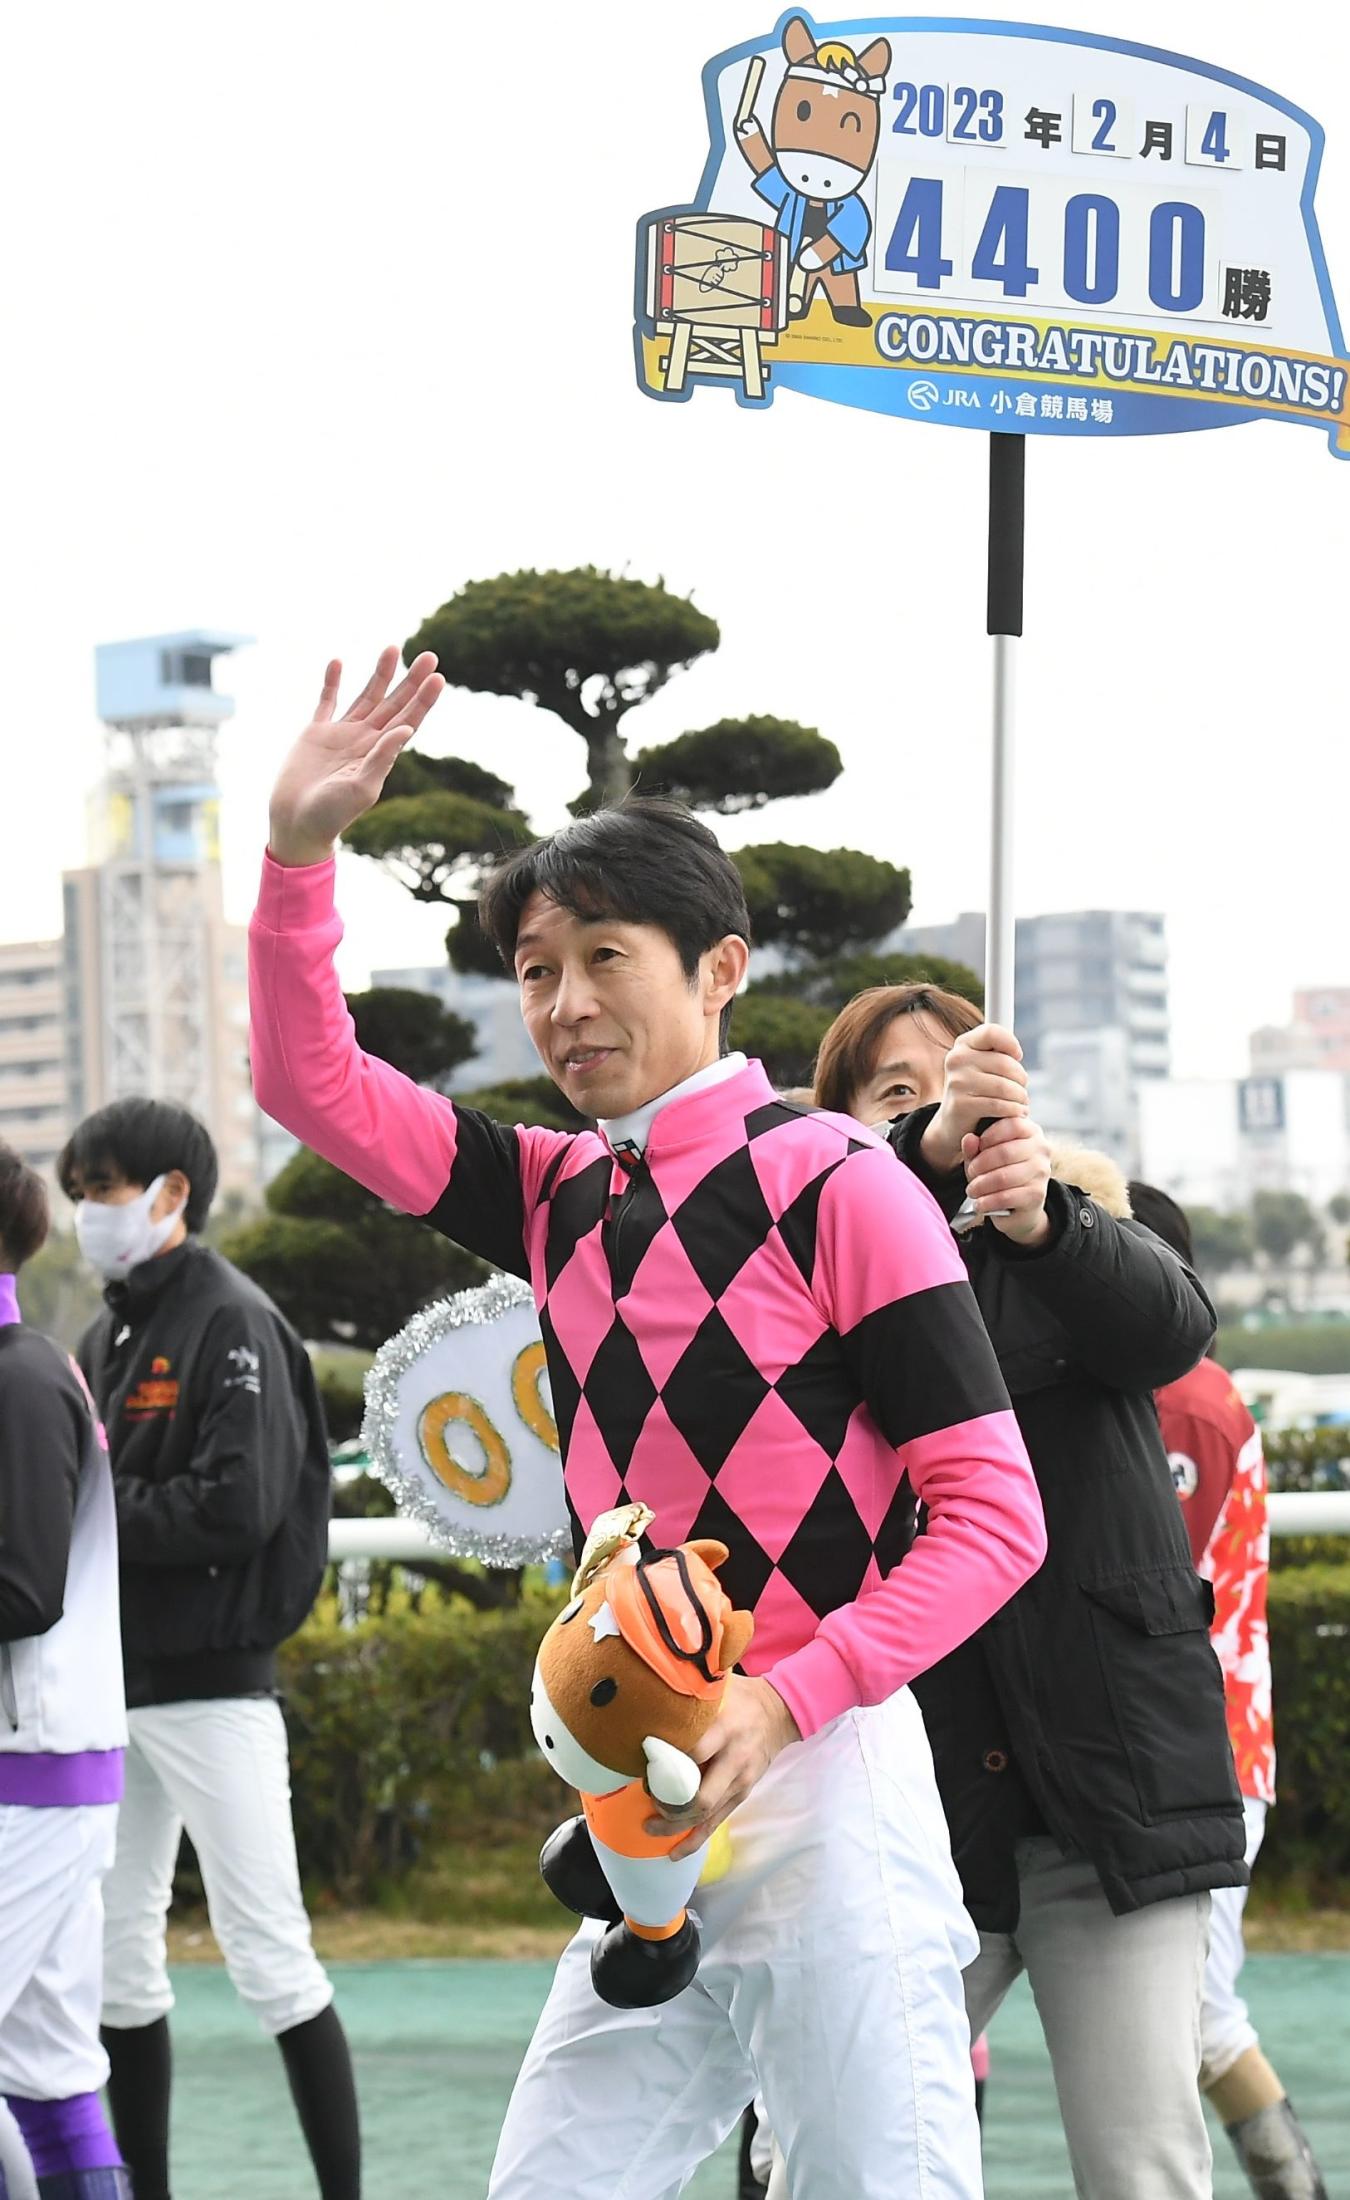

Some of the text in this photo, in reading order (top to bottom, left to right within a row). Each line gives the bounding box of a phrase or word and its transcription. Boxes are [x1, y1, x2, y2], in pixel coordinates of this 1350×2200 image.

[877, 314, 1345, 411] CONGRATULATIONS!
[943, 389, 1113, 424] JRA 小倉競馬場
